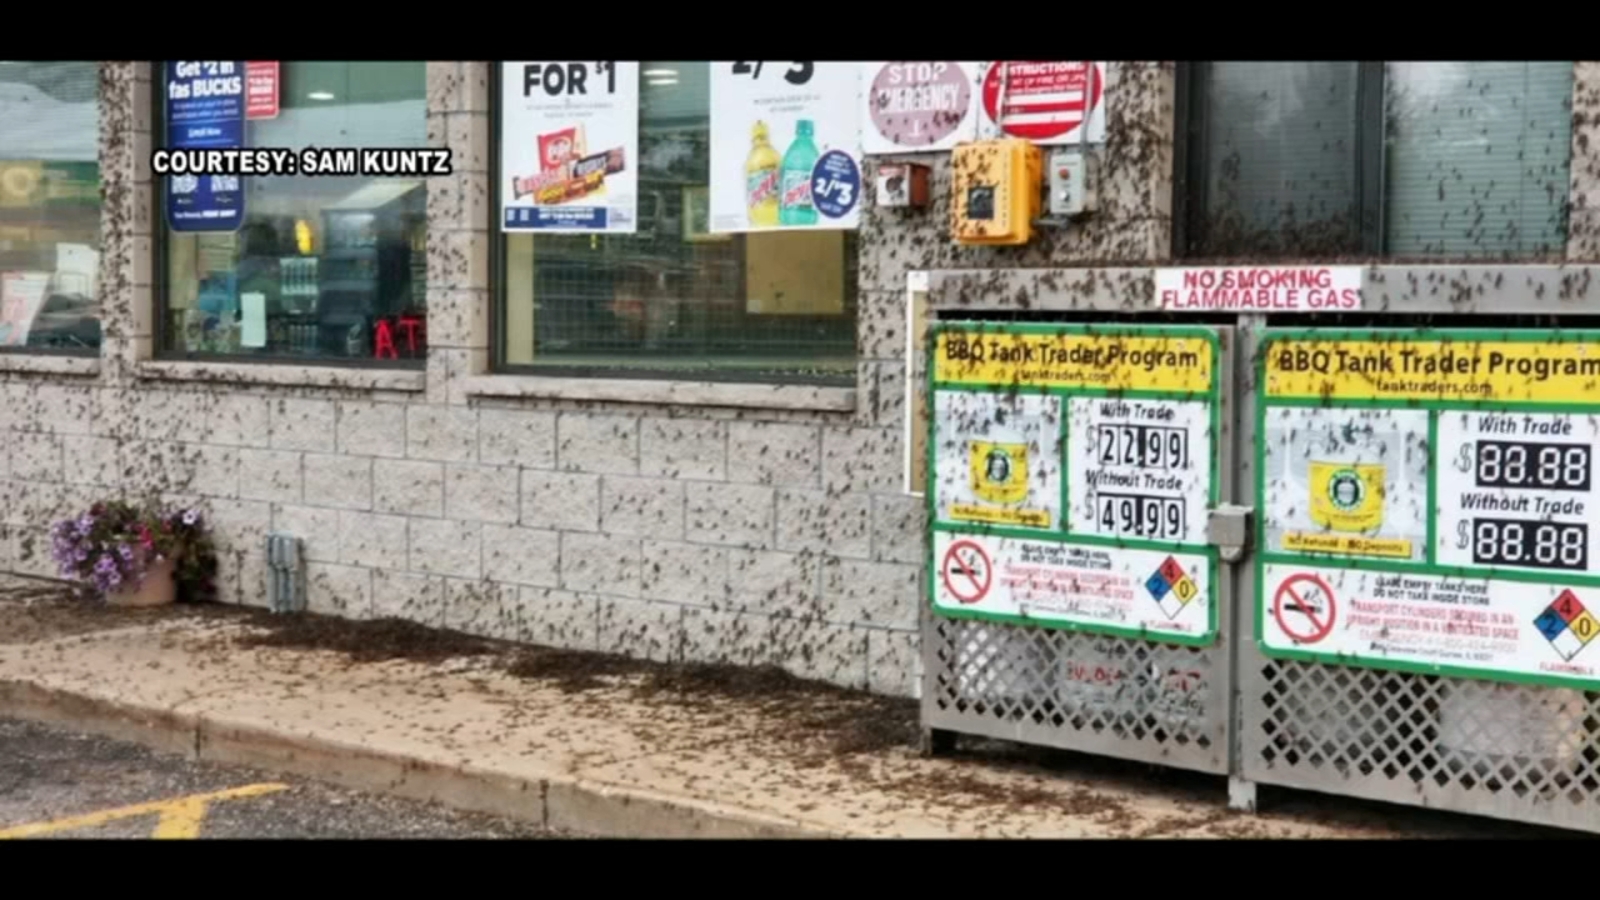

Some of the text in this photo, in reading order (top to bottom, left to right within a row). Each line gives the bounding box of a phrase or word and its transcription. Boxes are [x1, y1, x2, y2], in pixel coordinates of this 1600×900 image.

[176, 61, 200, 78] Get
[523, 63, 587, 97] FOR
[889, 62, 947, 84] STOP
[193, 76, 242, 97] BUCKS
[1183, 269, 1331, 290] NO SMOKING
[1161, 289, 1357, 309] FLAMMABLE GAS
[946, 340, 1198, 372] BBQ Tank Trader Program
[1279, 349, 1600, 382] BBQ Tank Trader Program
[1376, 379, 1493, 395] tanktraders.com
[1100, 402, 1175, 420] With Trade
[1479, 416, 1573, 436] With Trade
[1085, 469, 1183, 491] Without Trade
[1460, 493, 1585, 516] Without Trade
[1560, 597, 1573, 616] 4
[1544, 611, 1592, 638] 2 0
